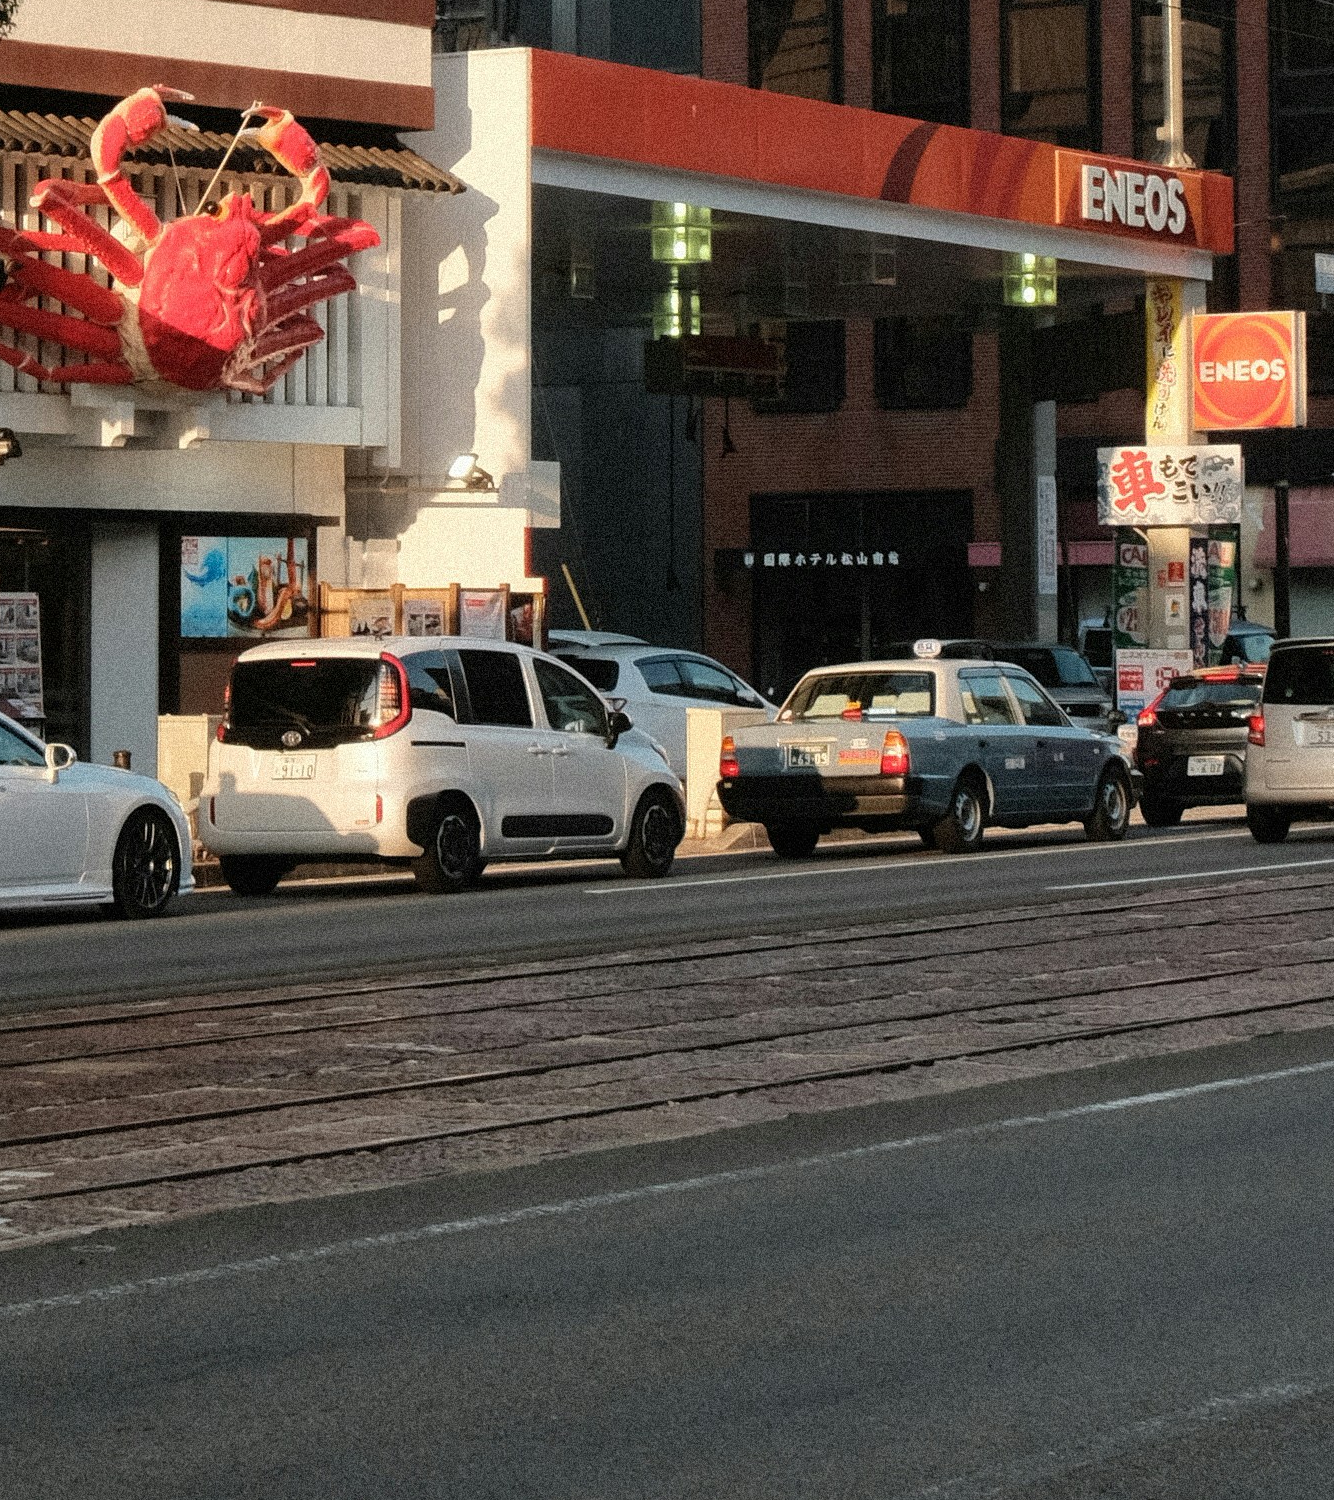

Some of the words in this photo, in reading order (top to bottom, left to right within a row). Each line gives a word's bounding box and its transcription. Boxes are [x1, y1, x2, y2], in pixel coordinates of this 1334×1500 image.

[1081, 163, 1187, 235] ENEOS
[1199, 357, 1286, 383] ENEOS
[1111, 450, 1165, 512] 車
[1159, 454, 1198, 479] もて
